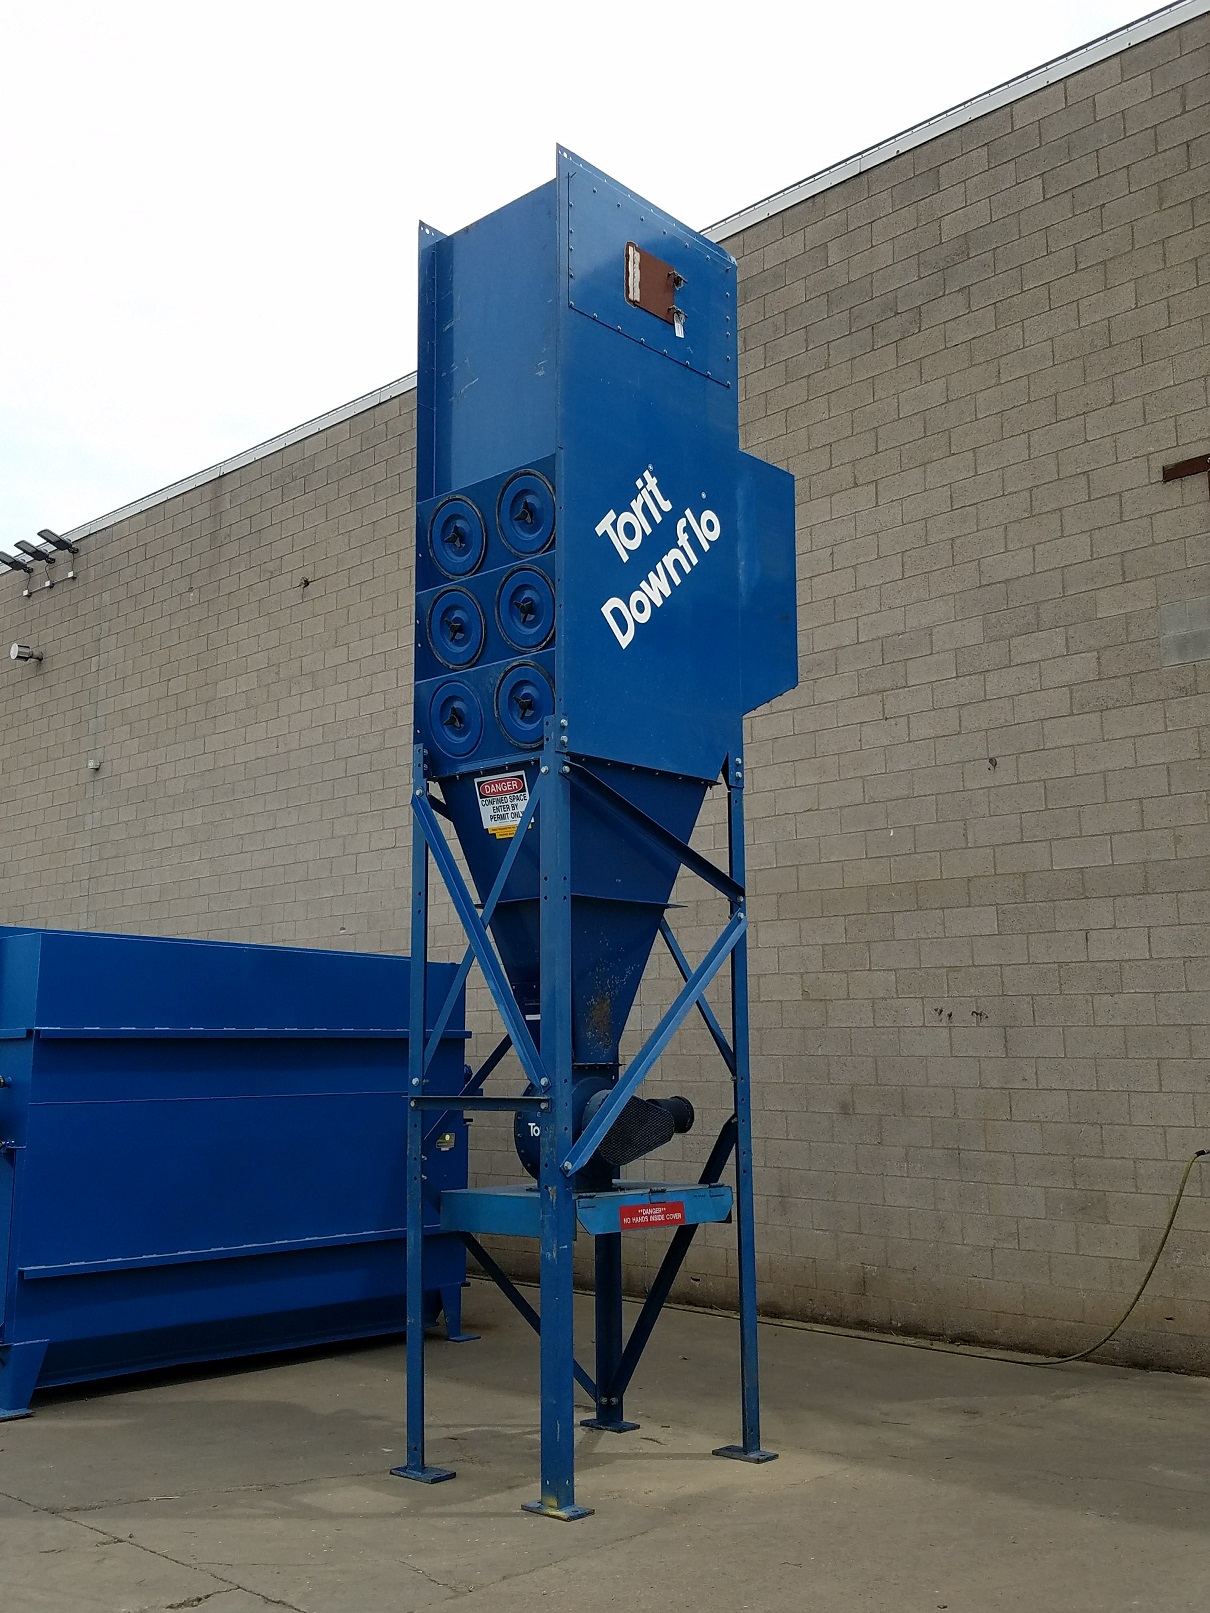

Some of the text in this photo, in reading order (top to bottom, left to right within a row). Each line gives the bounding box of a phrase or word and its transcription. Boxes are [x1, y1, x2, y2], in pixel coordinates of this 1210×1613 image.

[594, 469, 673, 564] Torit
[600, 507, 721, 650] Downflo
[484, 780, 518, 794] DANGER
[481, 793, 528, 807] CONFINED SPACE
[492, 803, 519, 814] ENTER BY
[489, 811, 523, 822] PERMIT ONL
[632, 1215, 649, 1223] HANDS
[649, 1214, 665, 1222] INSIDE
[666, 1212, 682, 1220] COVER
